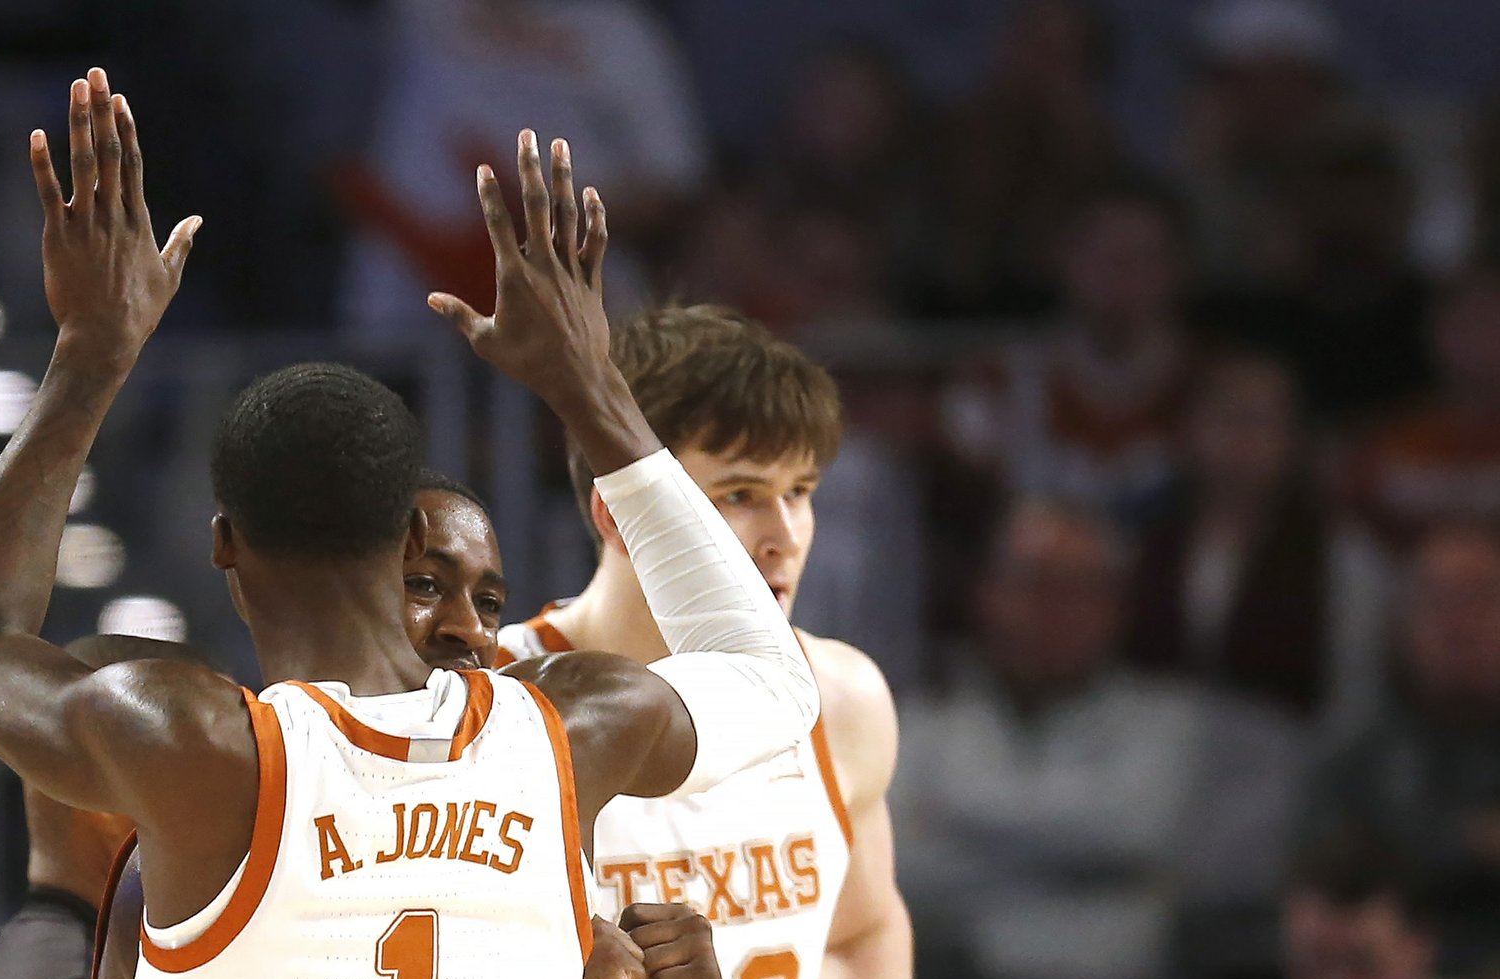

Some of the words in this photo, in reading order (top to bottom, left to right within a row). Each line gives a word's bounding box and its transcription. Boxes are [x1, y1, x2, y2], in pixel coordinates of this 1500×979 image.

[314, 813, 364, 881] A.
[375, 800, 534, 875] JONES
[596, 832, 822, 928] TEXAS
